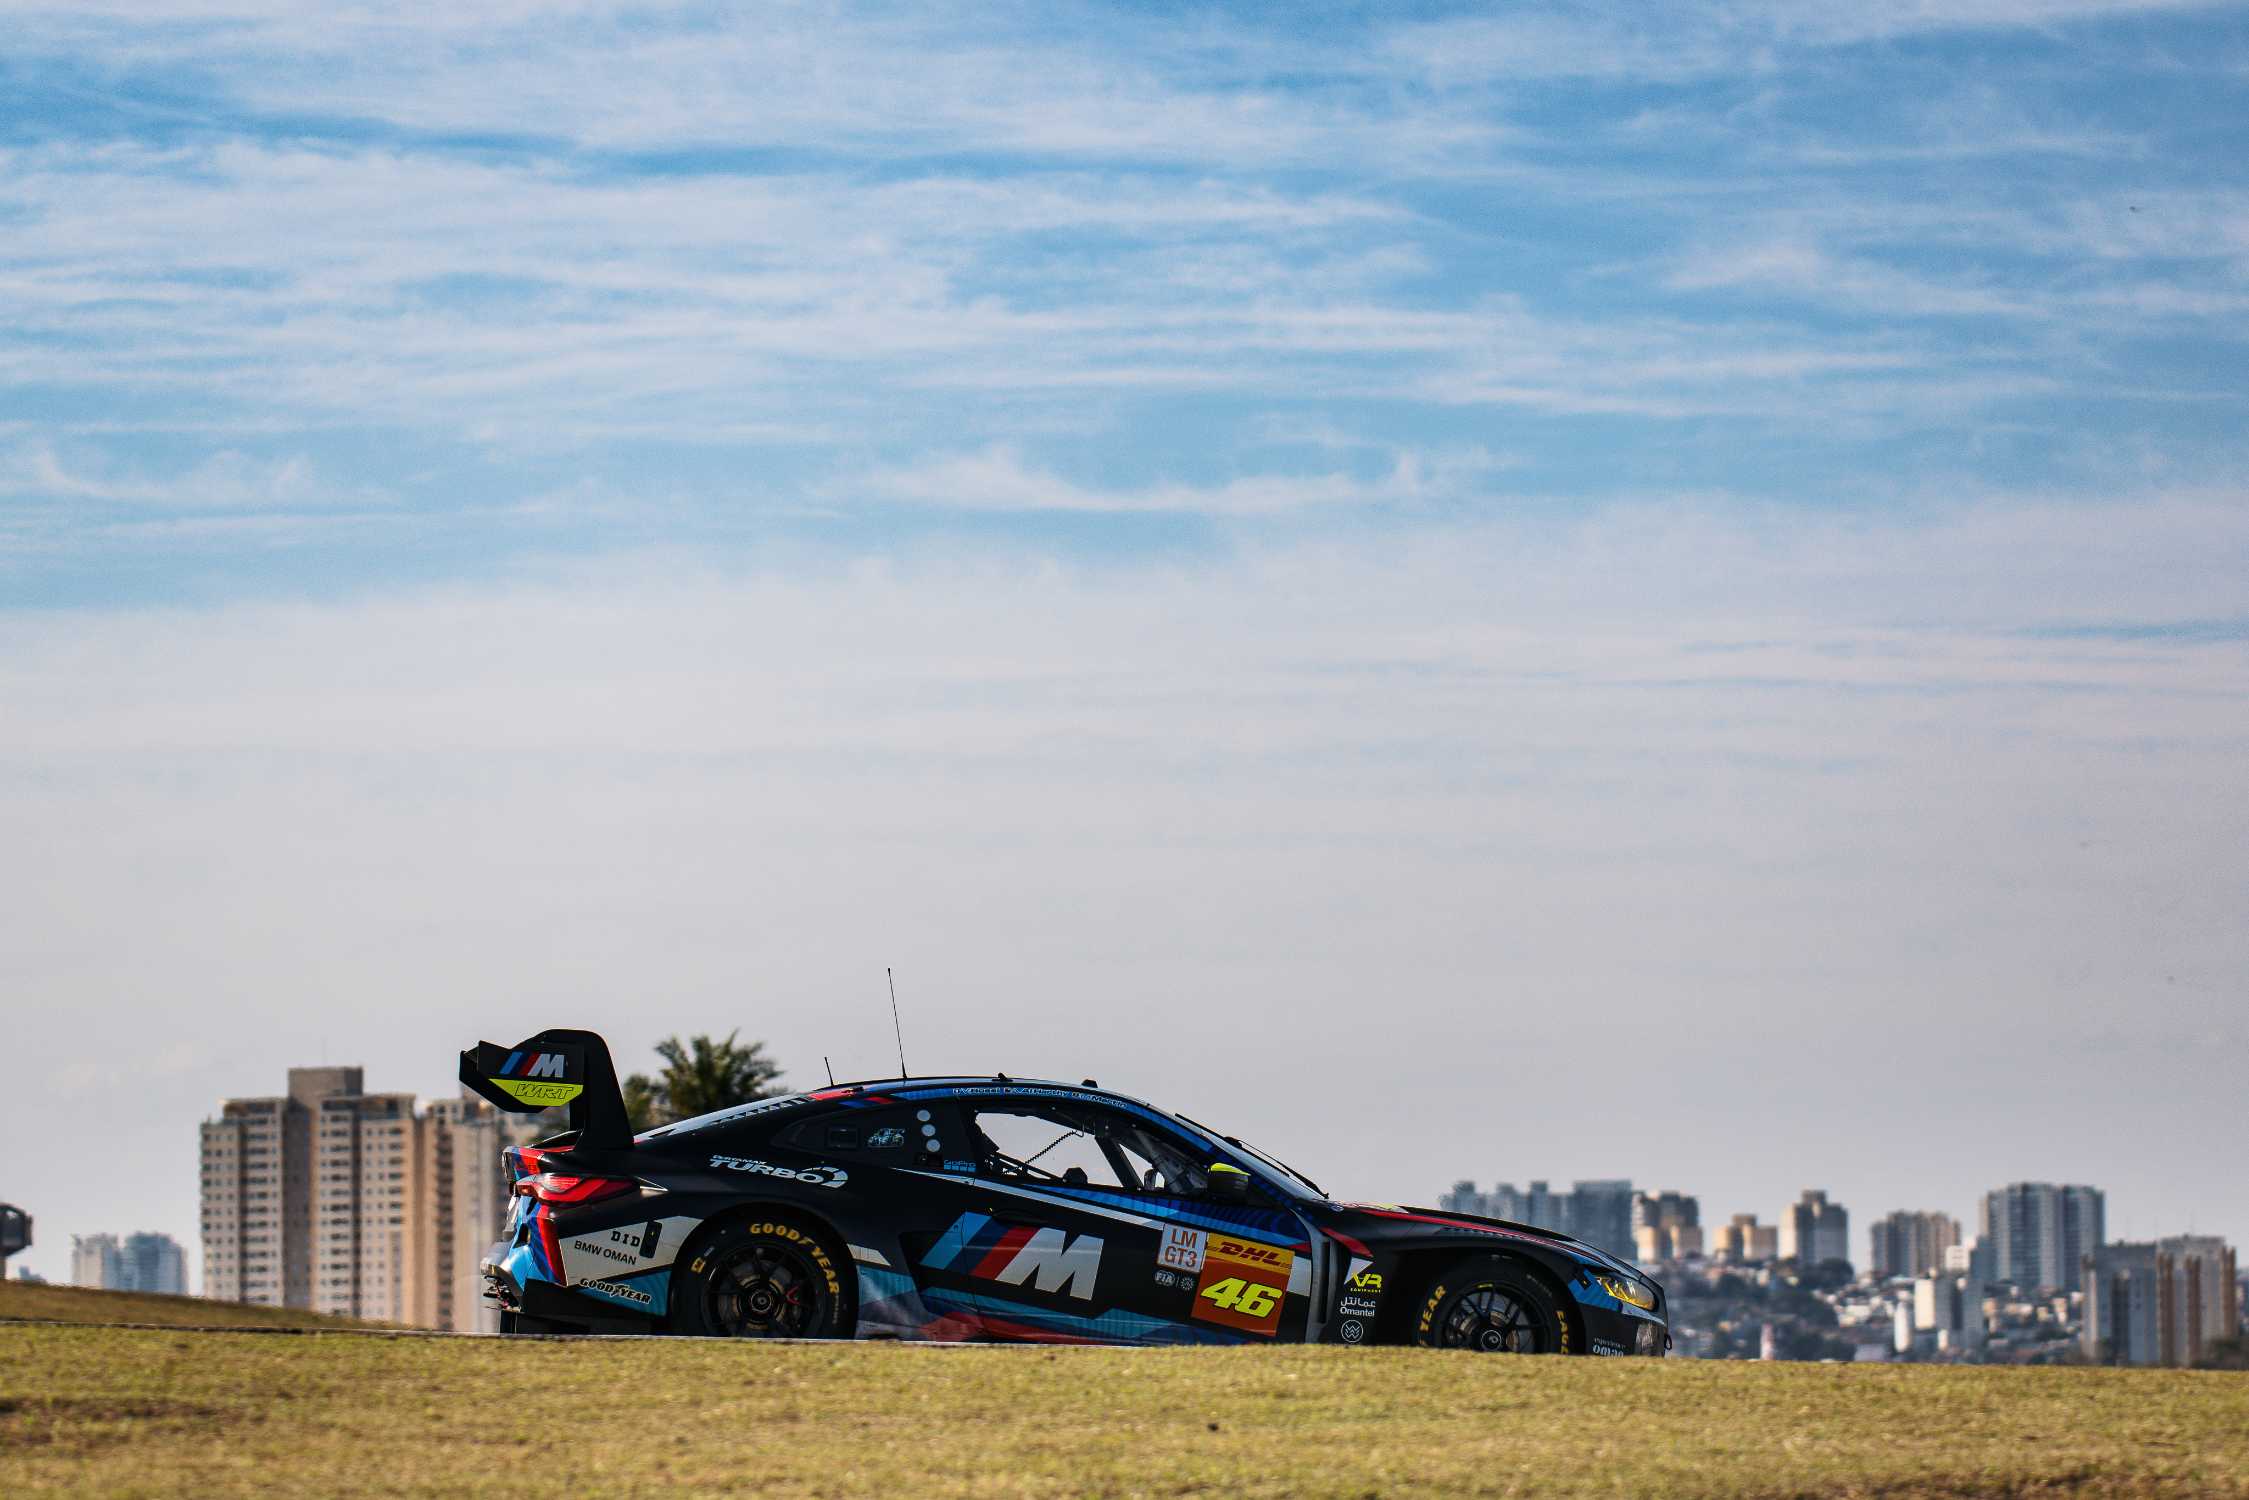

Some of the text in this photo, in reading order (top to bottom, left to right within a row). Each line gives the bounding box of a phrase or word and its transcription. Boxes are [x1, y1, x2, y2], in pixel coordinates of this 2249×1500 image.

[514, 1083, 574, 1100] WRT
[709, 1158, 824, 1184] TURBO
[1171, 1228, 1198, 1249] LM
[574, 1240, 637, 1266] BMW OMAN
[750, 1222, 840, 1294] GOODYEAR
[994, 1227, 1105, 1300] M
[1164, 1245, 1198, 1268] GT3
[1219, 1241, 1281, 1266] DHL
[580, 1278, 652, 1304] GOODYEAR
[1200, 1277, 1283, 1318] 46
[1340, 1306, 1375, 1317] Omantel
